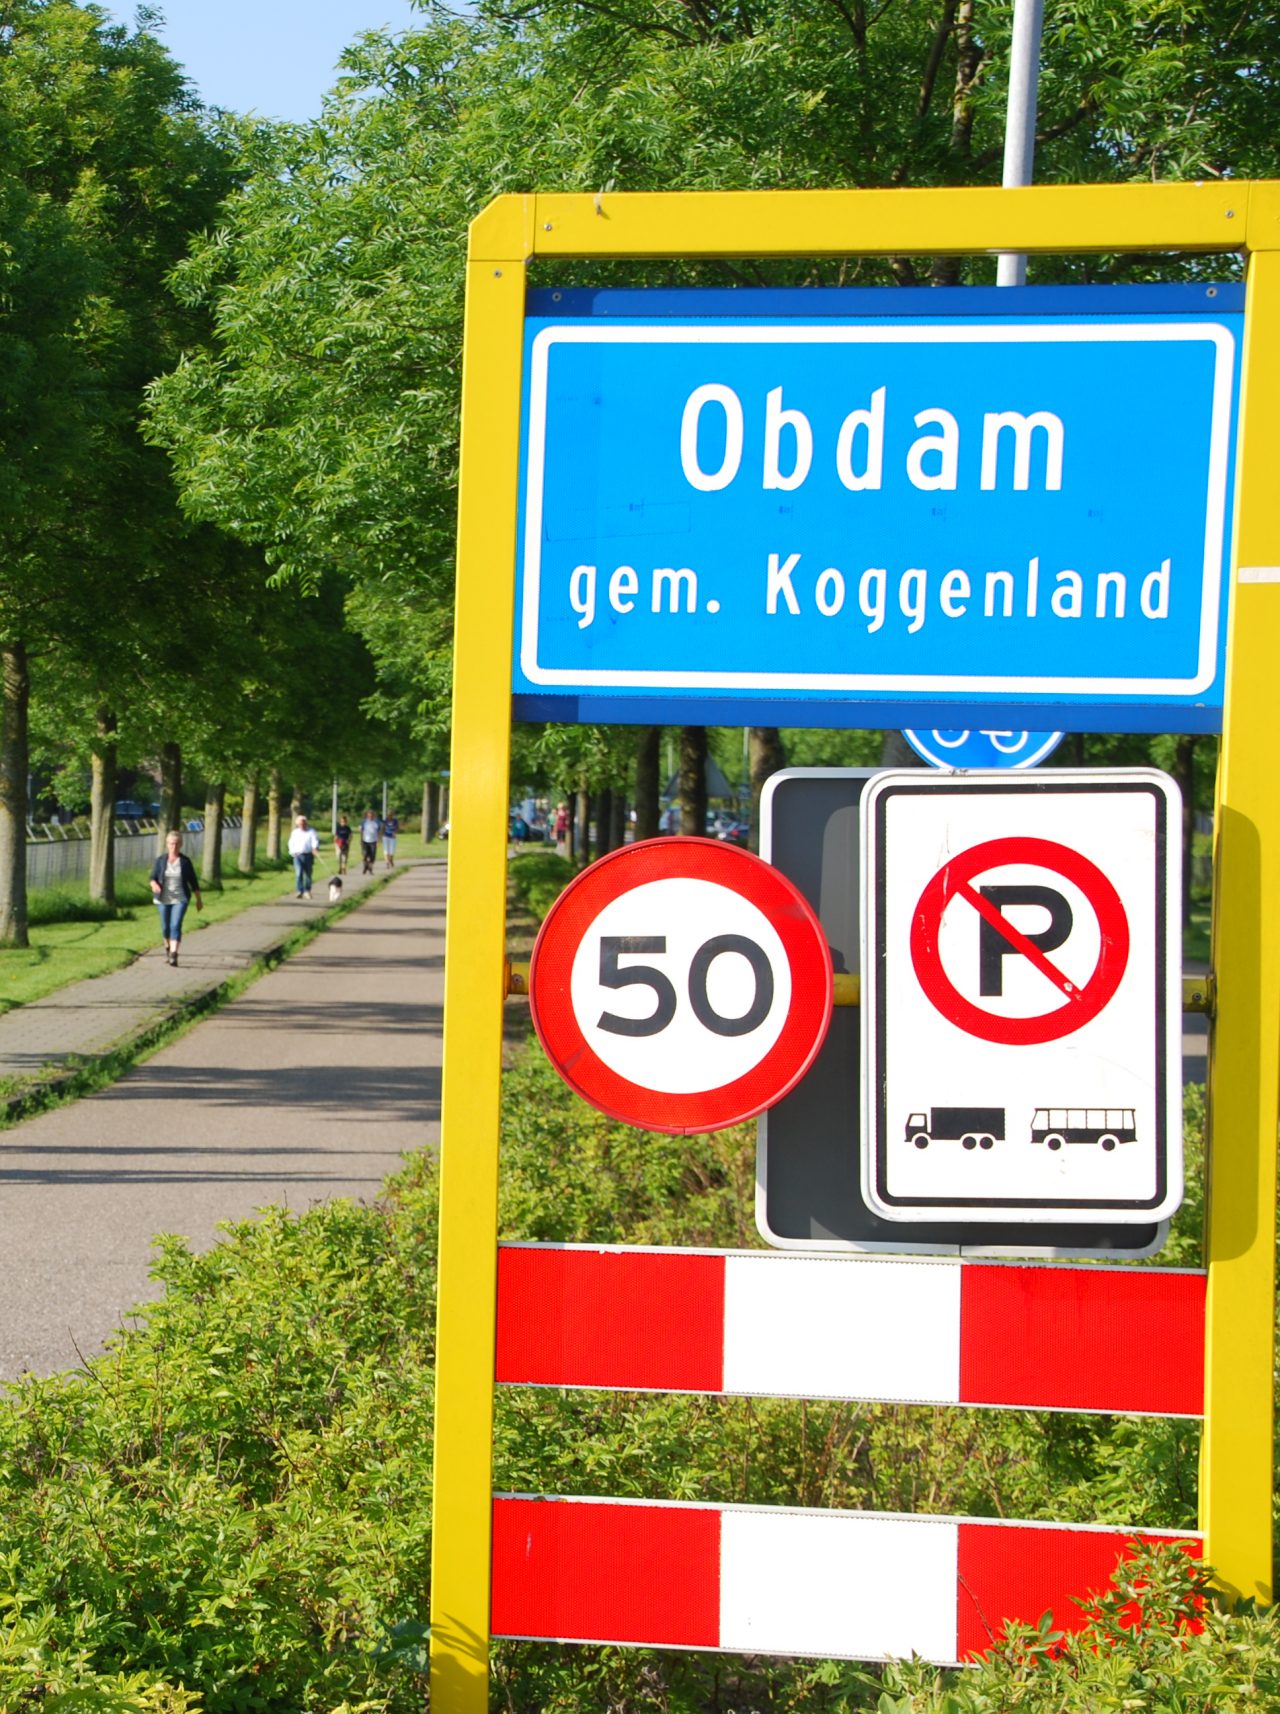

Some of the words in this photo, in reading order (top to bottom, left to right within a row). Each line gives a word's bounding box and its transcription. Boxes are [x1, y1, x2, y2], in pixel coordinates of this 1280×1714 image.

[680, 383, 1065, 492] Obdam
[569, 564, 721, 629] gem.
[766, 553, 1171, 634] Koggenland
[597, 934, 774, 1037] 50
[979, 885, 1074, 997] P
